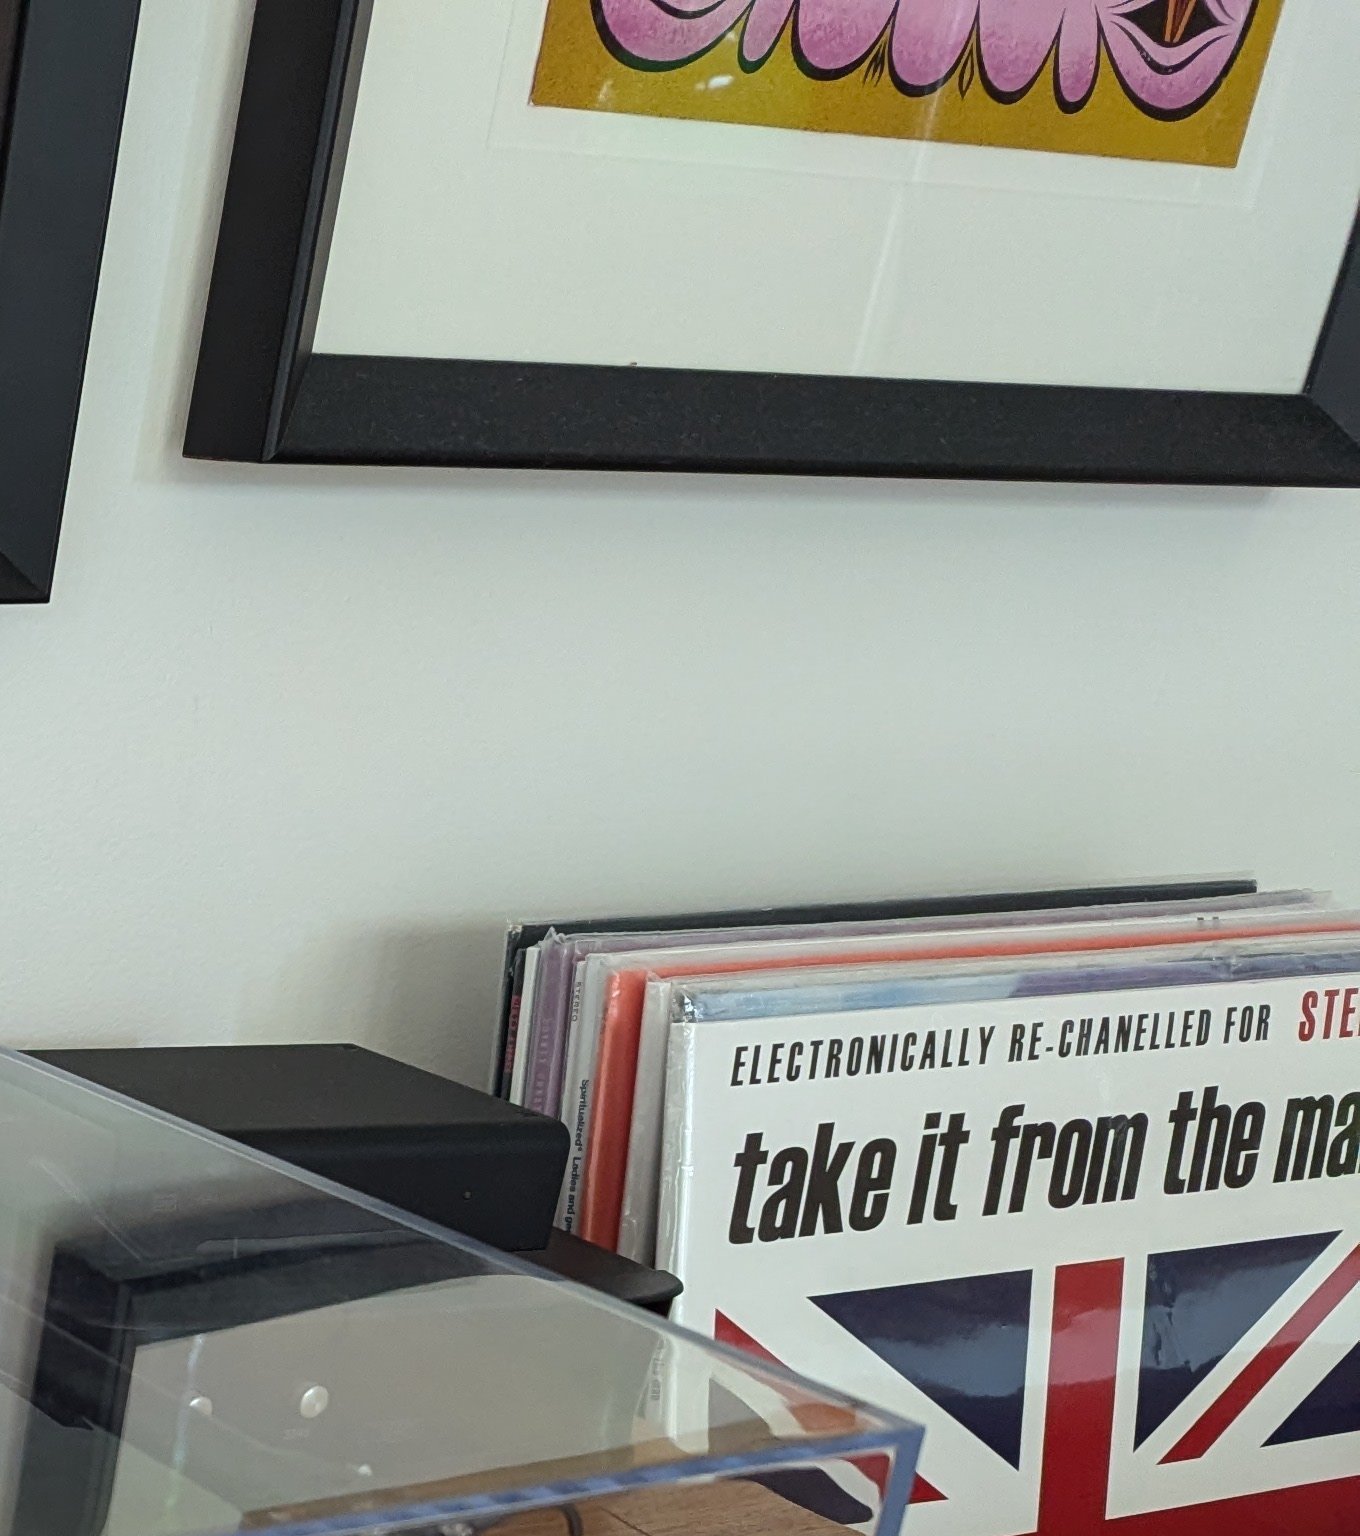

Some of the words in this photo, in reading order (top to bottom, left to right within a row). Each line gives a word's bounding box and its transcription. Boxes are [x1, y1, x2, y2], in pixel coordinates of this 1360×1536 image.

[730, 1025, 997, 1087] ELECTRONICALLY
[1007, 1008, 1212, 1064] RE-CHANELLED
[1223, 1004, 1272, 1044] FOR
[1298, 987, 1360, 1042] STE
[728, 1122, 898, 1246] take
[906, 1111, 971, 1226] it
[981, 1104, 1149, 1217] from
[1162, 1085, 1266, 1195] the
[1272, 1091, 1360, 1184] ma
